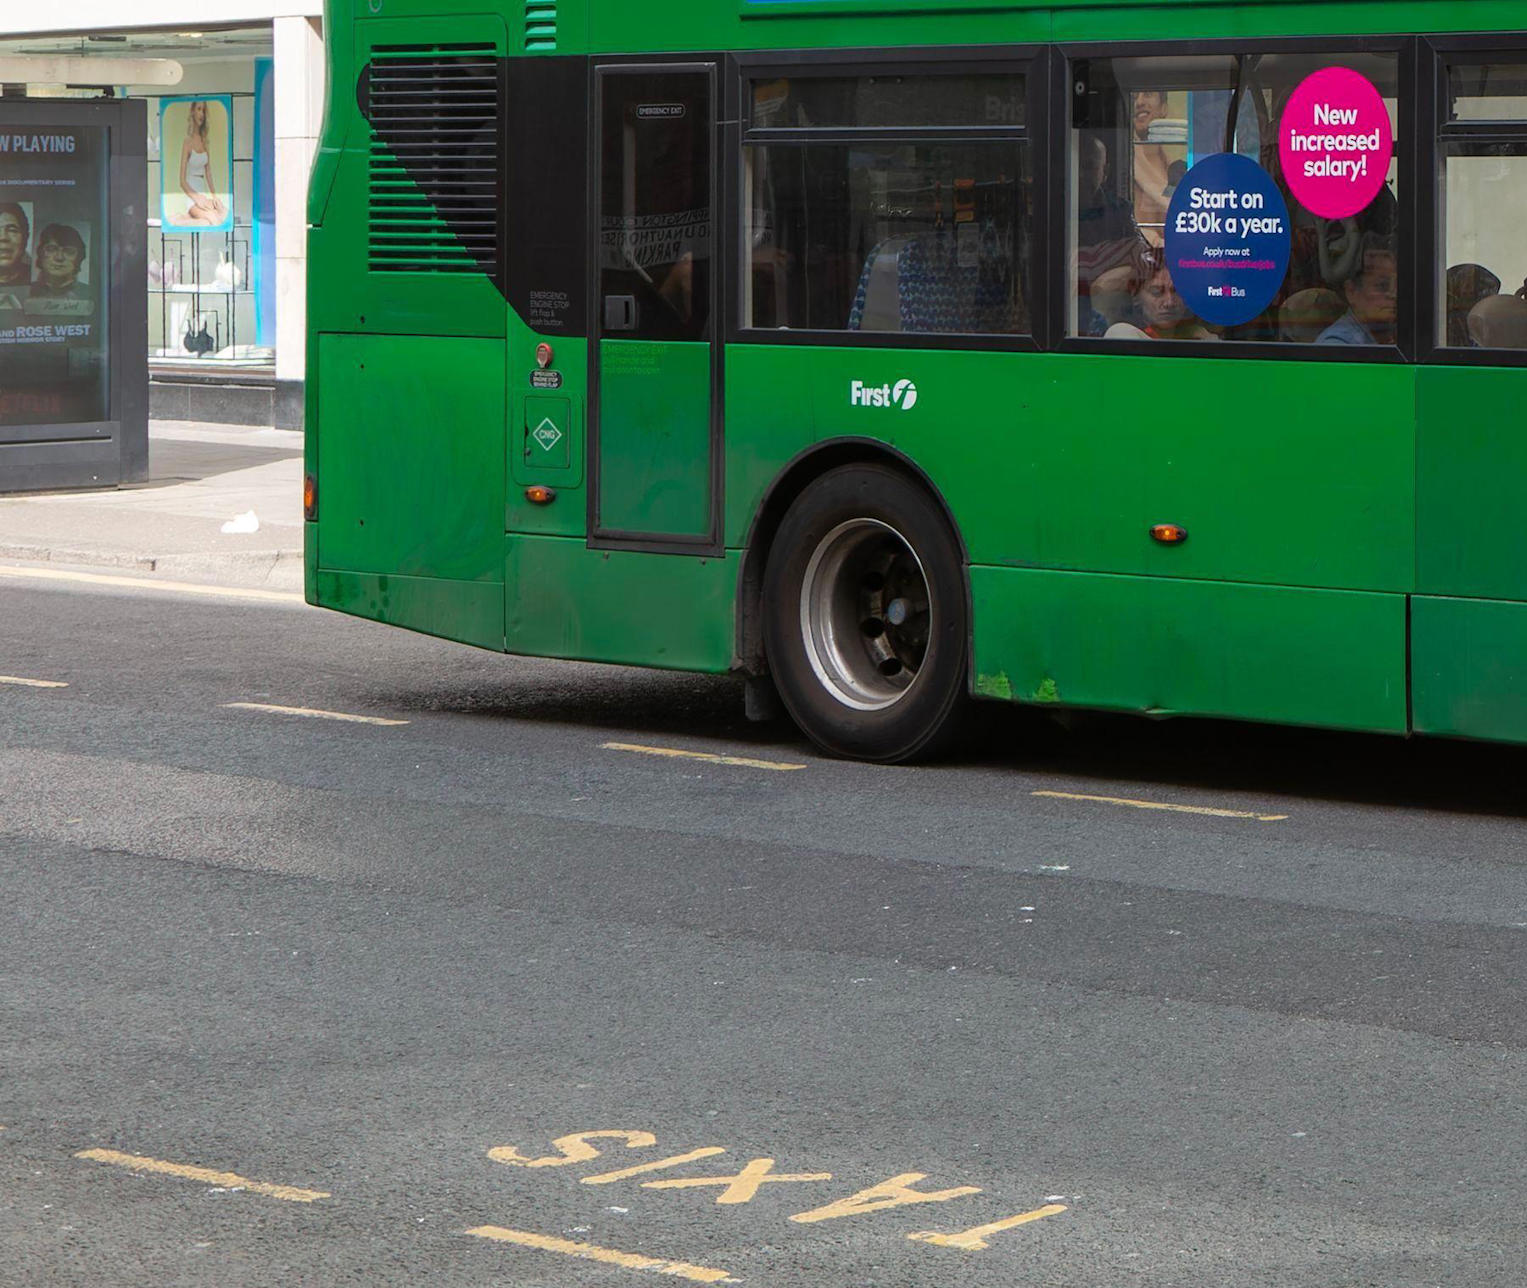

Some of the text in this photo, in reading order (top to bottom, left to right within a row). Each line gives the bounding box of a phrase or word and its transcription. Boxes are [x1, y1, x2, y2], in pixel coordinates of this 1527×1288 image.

[1313, 103, 1358, 126] New
[13, 135, 76, 152] PLAYING
[1291, 127, 1380, 152] increased
[1303, 154, 1367, 183] salary!
[1190, 187, 1263, 209] Start on
[1175, 212, 1284, 239] £30k a year.
[1203, 246, 1251, 258] Apply now at
[1208, 286, 1246, 297] First Bus
[16, 325, 52, 338] ROSE
[55, 324, 91, 336] WEST
[851, 380, 891, 407] First
[486, 1128, 1069, 1252] TAXIS
